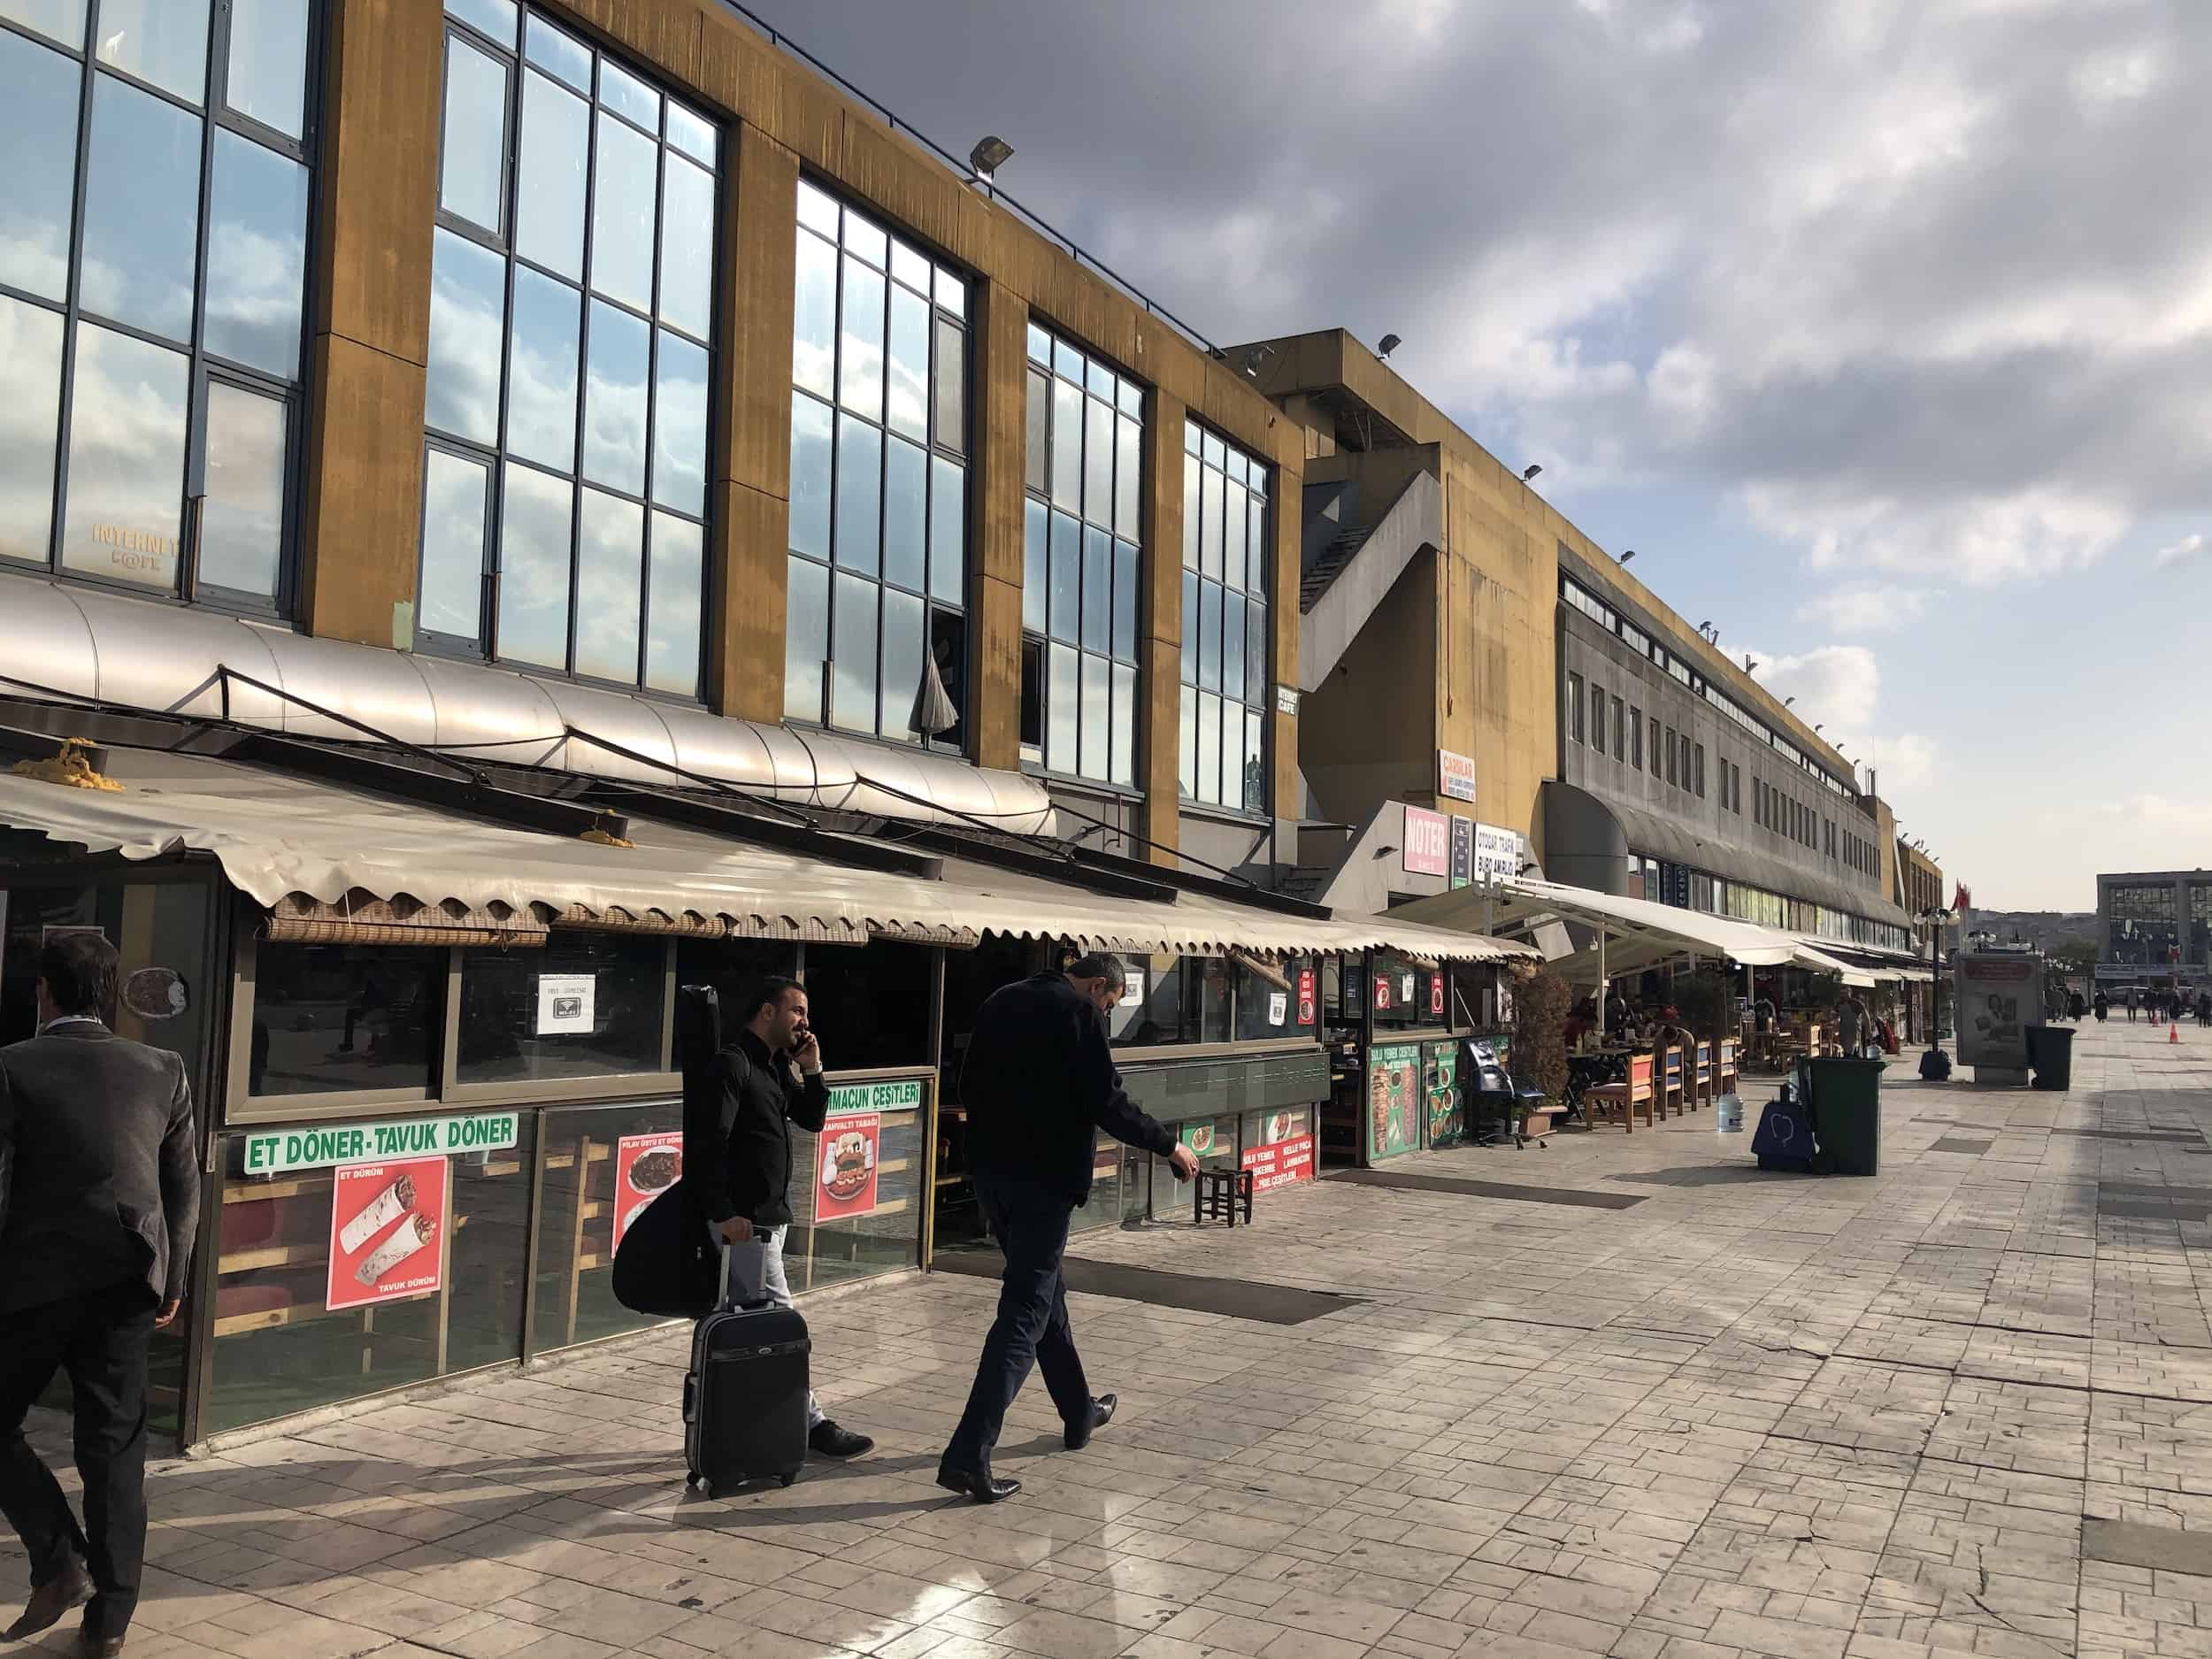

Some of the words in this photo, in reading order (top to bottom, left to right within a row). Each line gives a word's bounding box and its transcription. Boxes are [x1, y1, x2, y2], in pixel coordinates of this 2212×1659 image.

[1407, 816, 1445, 858] NOTER
[872, 1083, 919, 1110] ÇEŞİTLERİ
[250, 1137, 280, 1169] ET
[448, 1115, 513, 1148] DÖNER
[340, 1171, 351, 1181] ET
[353, 1167, 384, 1179] DÜRÜM
[379, 1282, 405, 1294] TAVUK
[407, 1275, 436, 1288] DÜRÜM
